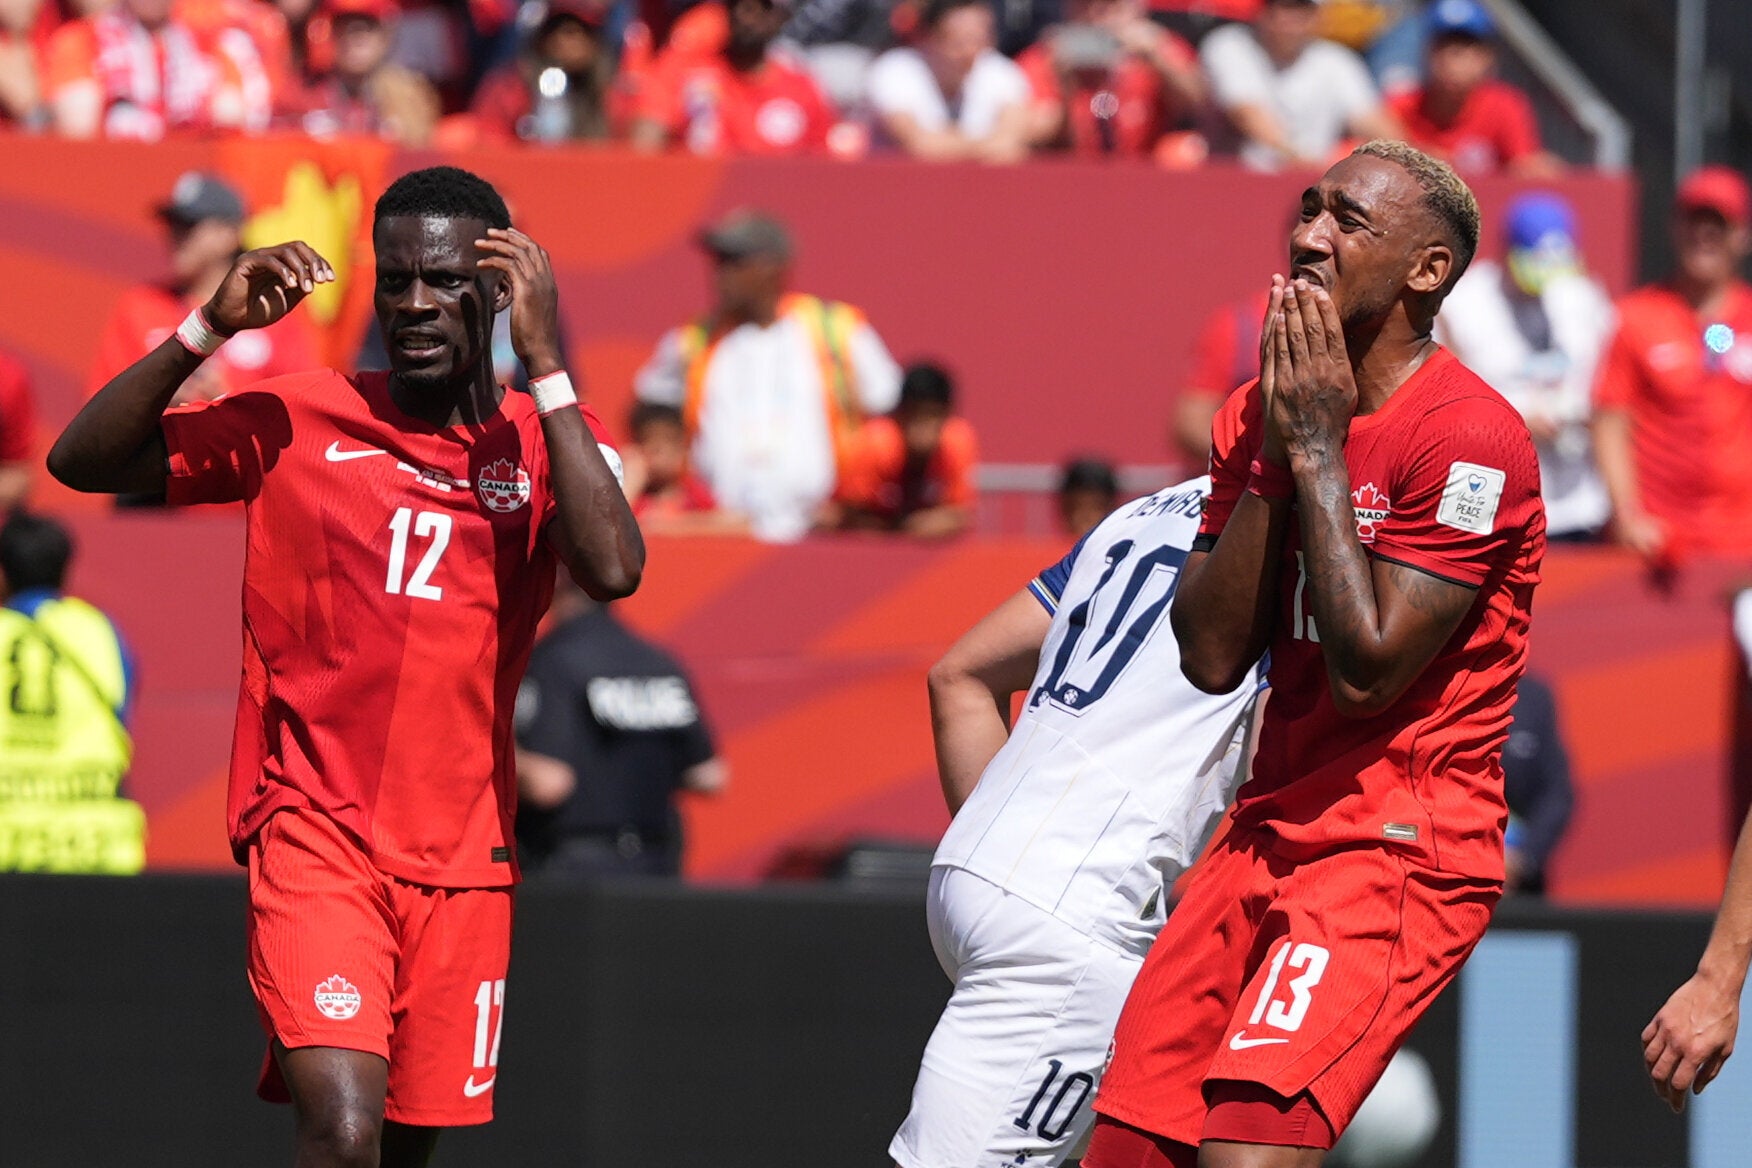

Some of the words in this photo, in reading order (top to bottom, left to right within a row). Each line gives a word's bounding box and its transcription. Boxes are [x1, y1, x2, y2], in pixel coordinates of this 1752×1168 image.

[479, 480, 529, 492] CANADA
[1455, 503, 1483, 519] PEACE
[385, 506, 453, 601] 12
[1028, 539, 1191, 714] 10
[316, 993, 360, 1002] CANADA
[1248, 941, 1331, 1032] 13
[1012, 1058, 1094, 1144] 10
